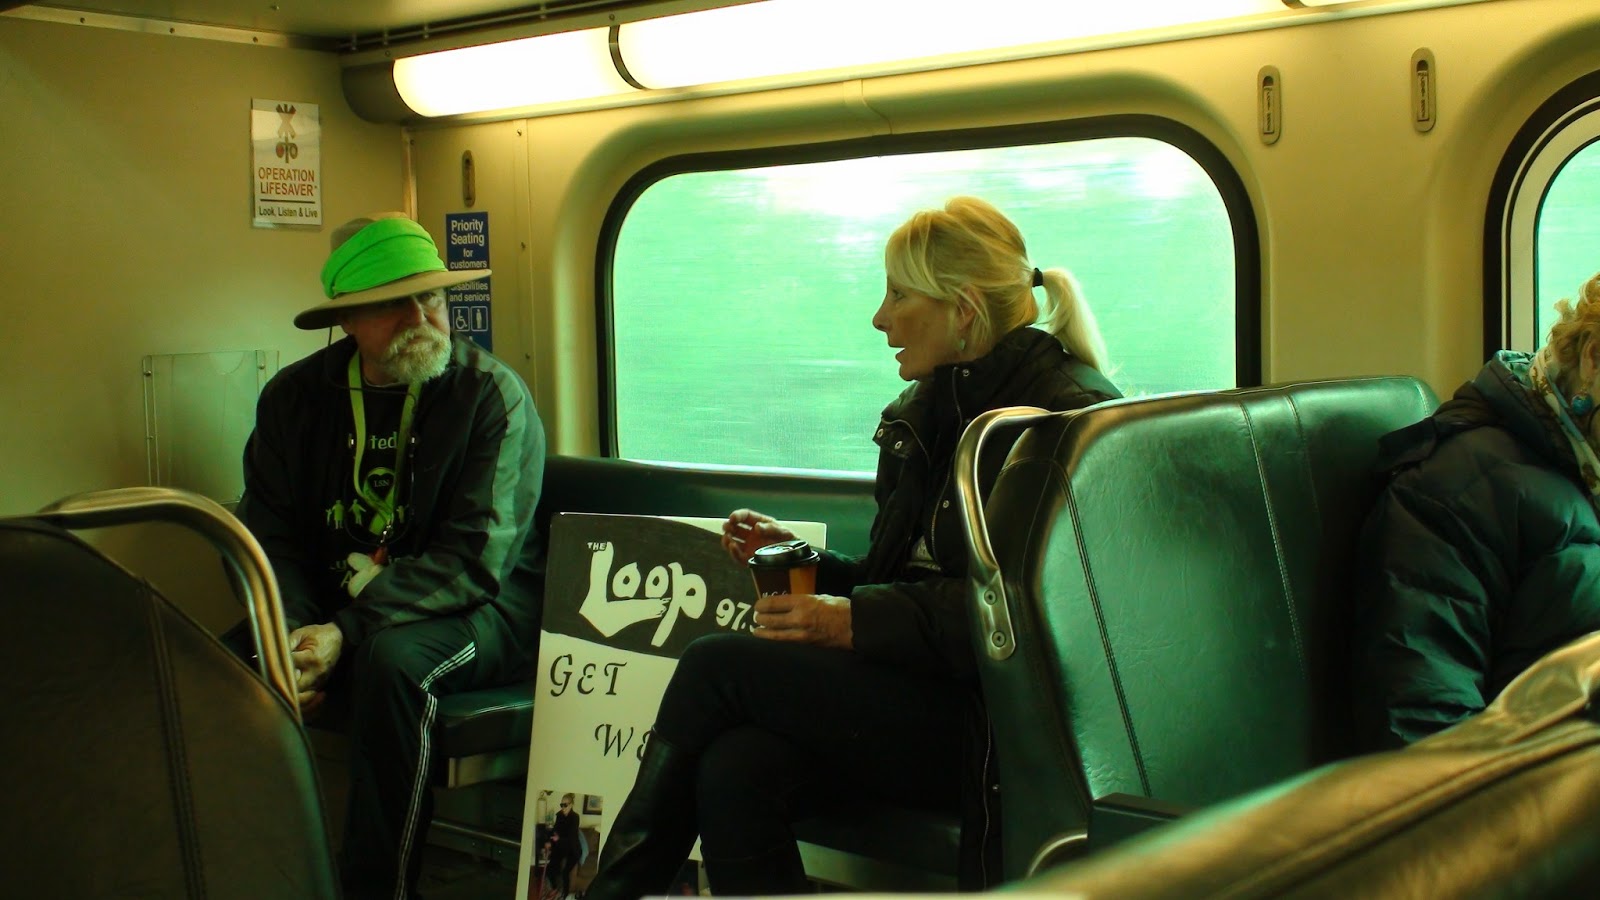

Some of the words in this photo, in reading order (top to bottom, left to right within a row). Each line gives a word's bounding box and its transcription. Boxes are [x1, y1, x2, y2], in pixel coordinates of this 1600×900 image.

[258, 167, 315, 182] OPERATION
[260, 182, 314, 196] LIFESAVER
[259, 206, 276, 217] Look,
[278, 207, 297, 217] Listen
[298, 207, 304, 217] &
[305, 208, 318, 218] Live
[451, 219, 483, 233] Priority
[451, 233, 485, 246] Seating
[463, 248, 474, 258] for
[450, 260, 487, 269] customers
[450, 293, 463, 301] and
[464, 292, 490, 301] seniors
[587, 542, 606, 551] THE
[579, 541, 707, 647] Loop
[550, 654, 627, 697] GET
